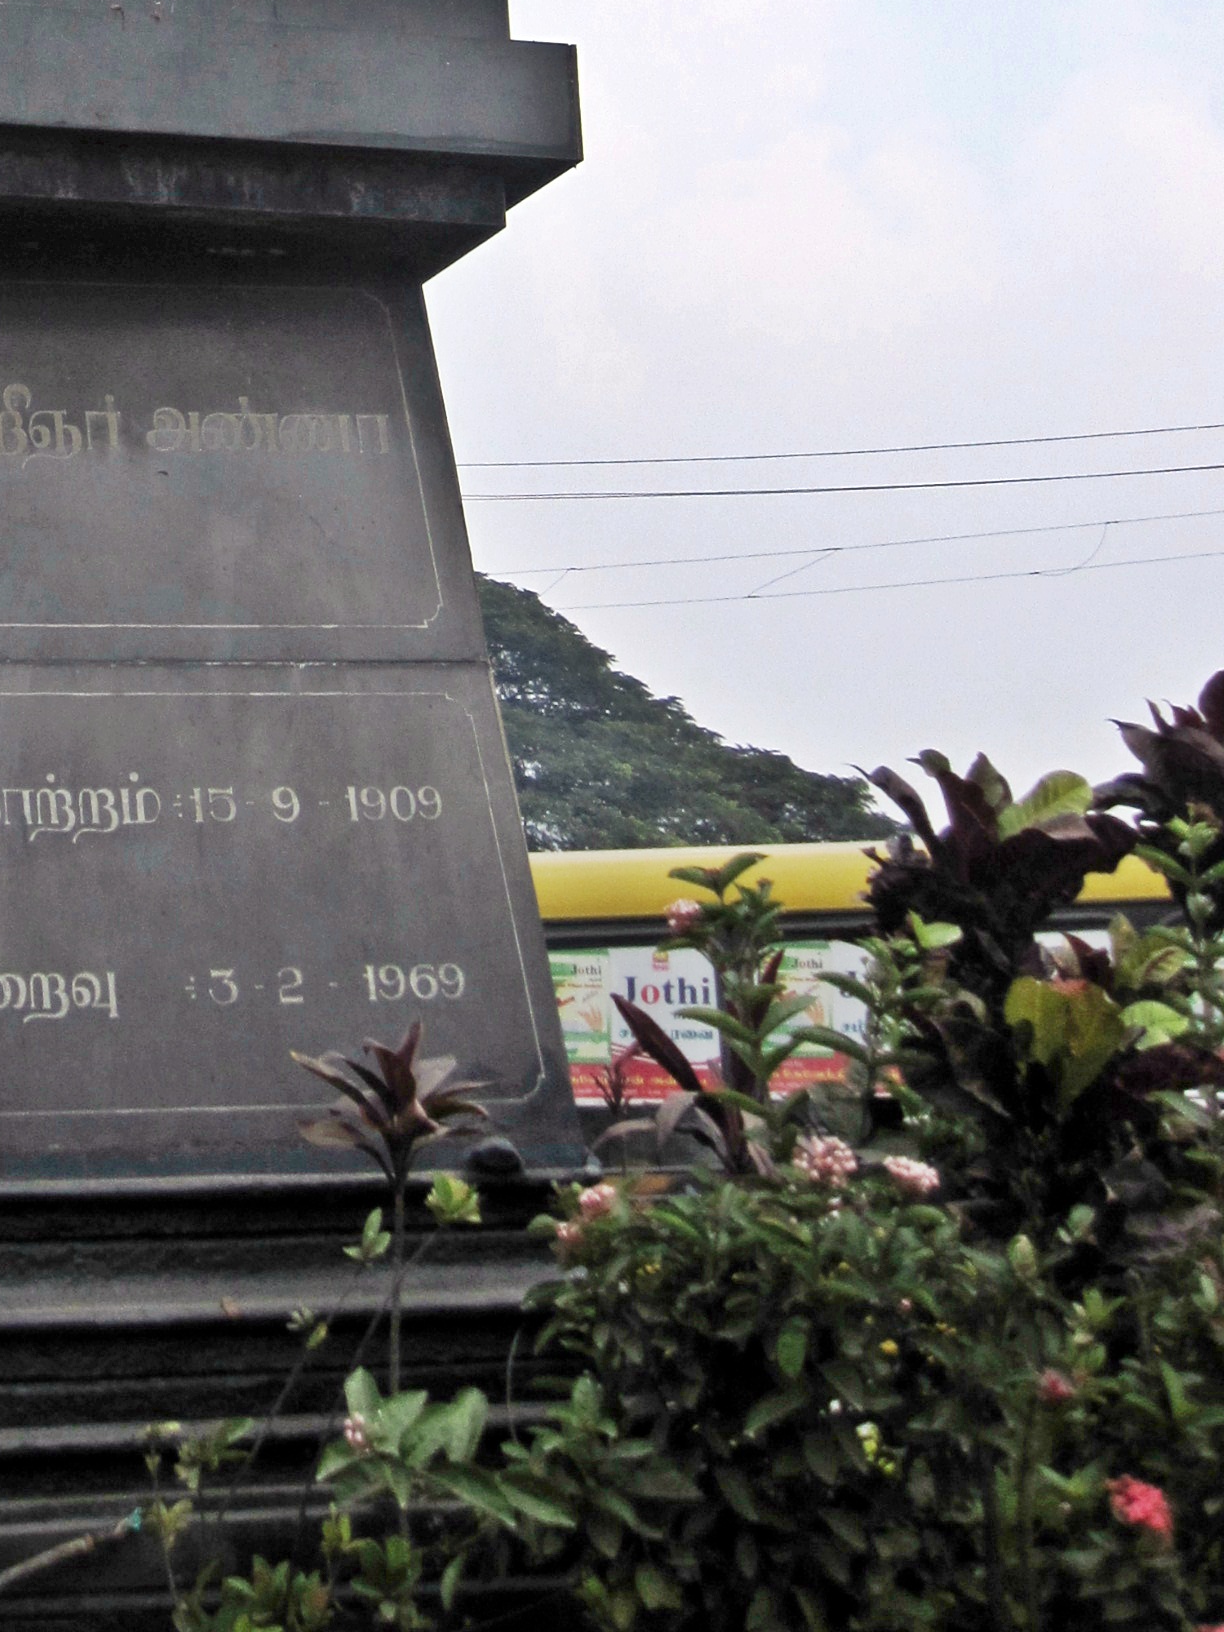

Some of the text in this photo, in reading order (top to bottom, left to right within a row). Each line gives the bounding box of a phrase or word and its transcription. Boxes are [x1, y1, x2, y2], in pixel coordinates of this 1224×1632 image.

[271, 785, 301, 823] 9
[344, 785, 443, 822] 1909
[208, 968, 239, 1006] 3
[277, 967, 304, 1004] 2
[362, 962, 466, 1002] 1969
[624, 976, 711, 1005] Jothi
